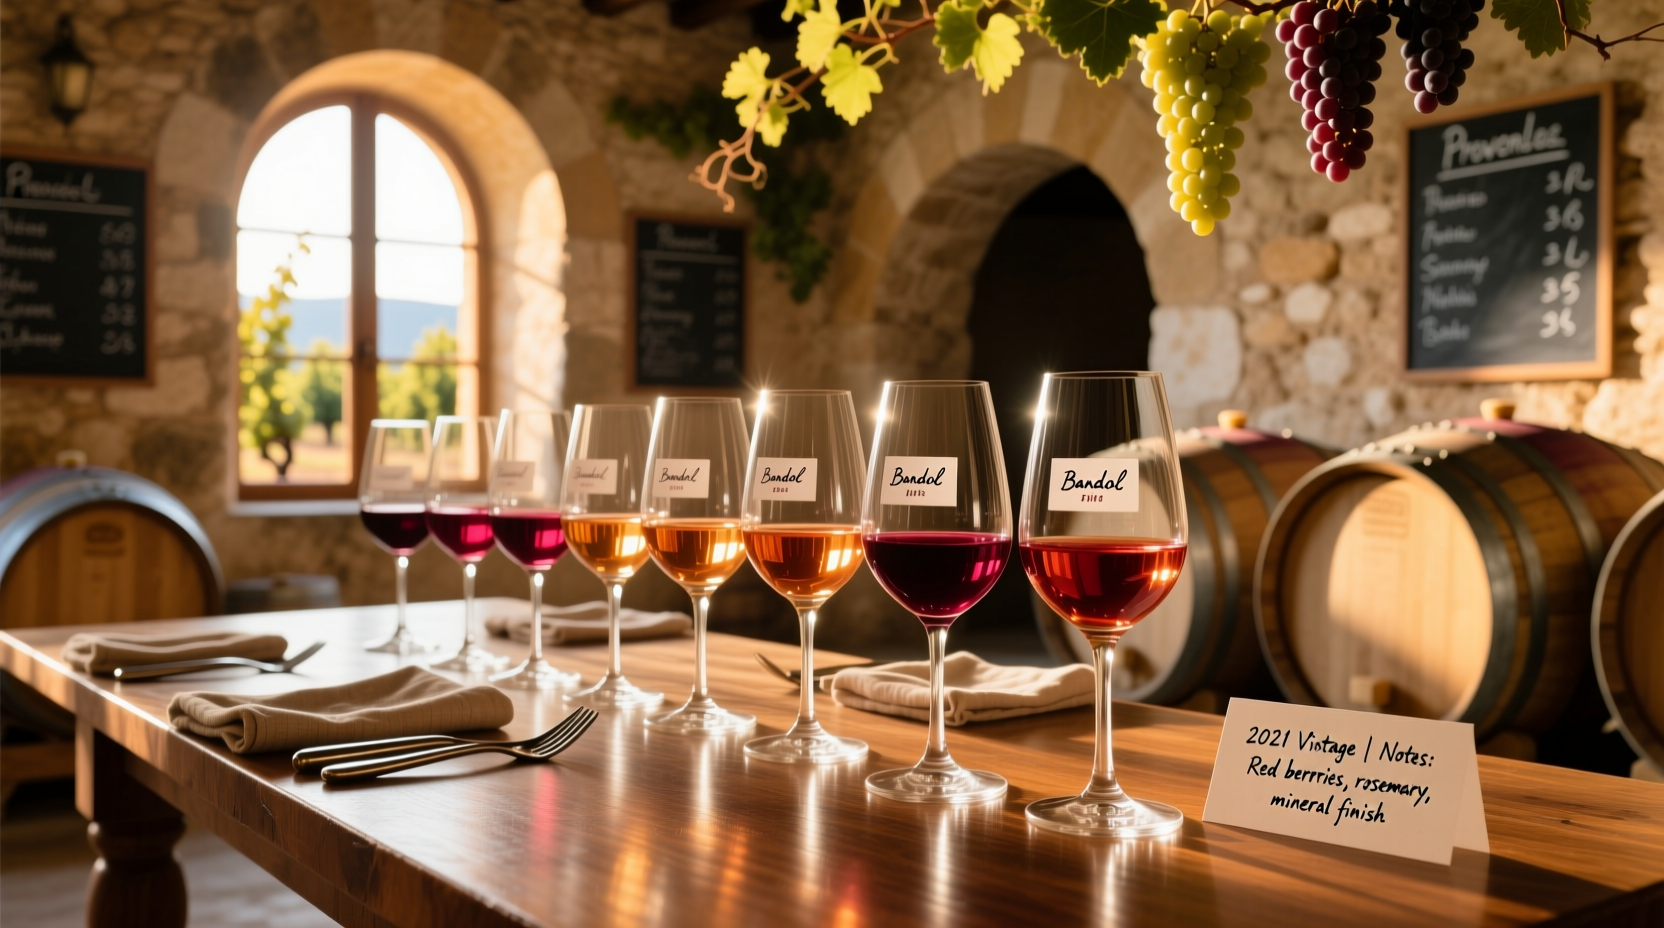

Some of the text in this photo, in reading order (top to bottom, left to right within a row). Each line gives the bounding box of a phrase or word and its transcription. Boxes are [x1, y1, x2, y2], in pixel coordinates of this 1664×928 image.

[1540, 271, 1582, 306] 35
[760, 467, 807, 484] Bandol
[889, 467, 946, 486] Bandol
[1061, 469, 1128, 491] Bandol
[1246, 726, 1290, 748] 2021
[1299, 730, 1356, 764] Vintage
[1379, 741, 1435, 767] Notes:
[1247, 755, 1281, 778] Red
[1355, 777, 1431, 807] rosemary,
[1270, 793, 1386, 827] mineral finish
